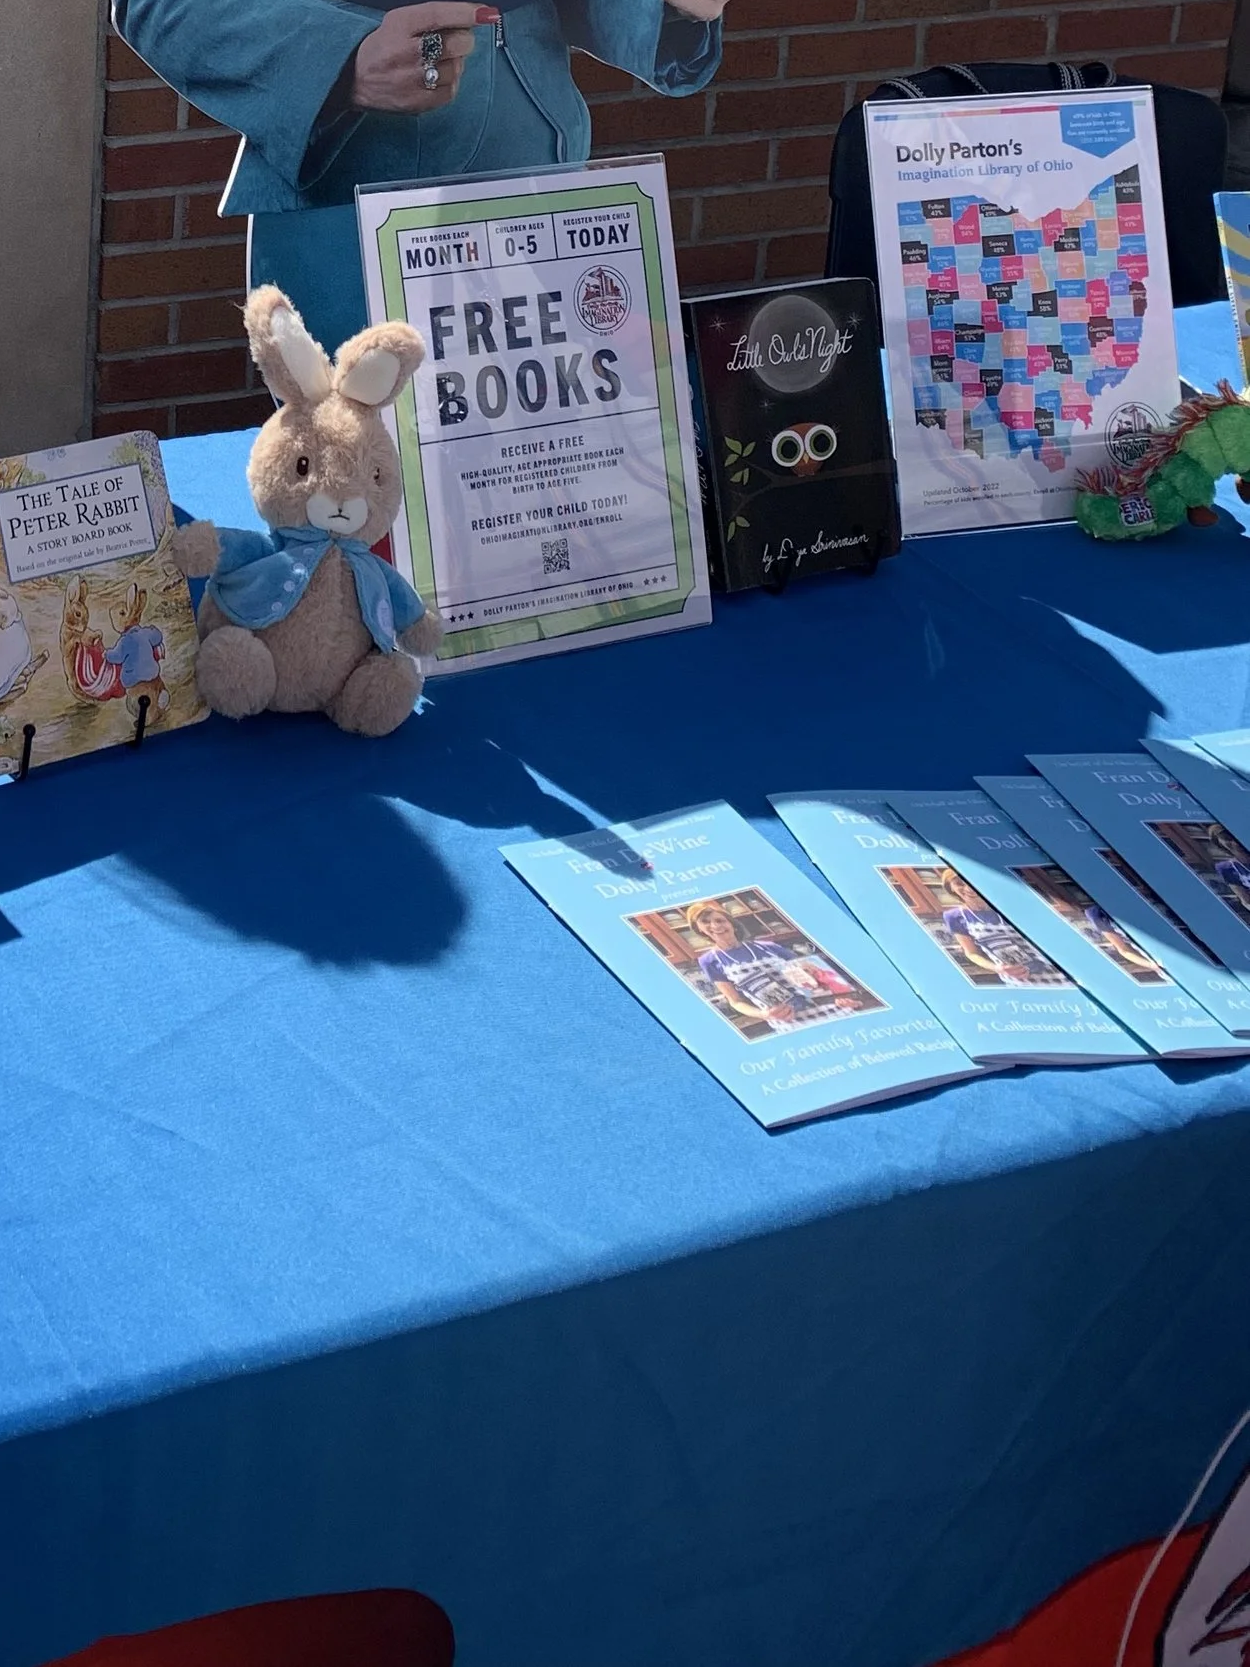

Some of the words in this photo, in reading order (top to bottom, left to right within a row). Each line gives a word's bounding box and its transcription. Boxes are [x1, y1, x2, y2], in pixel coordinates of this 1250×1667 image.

[896, 144, 945, 166] Dolly
[950, 139, 1023, 160] Parton's
[897, 167, 974, 183] Imagination
[978, 164, 1023, 178] Library
[1026, 161, 1039, 173] of
[1042, 160, 1073, 171] Ohio
[495, 224, 526, 234] CHILDREN
[528, 222, 545, 231] AGES
[563, 216, 593, 226] REGISTER
[594, 214, 611, 224] YOUR
[612, 212, 631, 222] CHILD
[412, 234, 428, 244] FREE
[430, 233, 451, 242] BOOKS
[453, 231, 470, 240] EACH
[505, 235, 538, 258] 0-5
[566, 223, 630, 250] TODAY
[406, 241, 479, 270] MONTH
[429, 291, 567, 361] FREE
[726, 334, 764, 371] Little
[806, 326, 854, 373] Night
[436, 348, 622, 426] BOOKS
[501, 441, 545, 458] RECEIVE
[549, 440, 555, 451] A
[559, 435, 585, 449] FREE
[460, 464, 515, 481] HIGH-QUALITY,
[517, 462, 531, 472] AGE
[533, 454, 582, 469] APPROPRIATE
[584, 450, 604, 460] BOOK
[605, 447, 624, 457] EACH
[470, 479, 496, 490] MONTH
[498, 477, 513, 485] FOR
[514, 468, 559, 483] REGISTERED
[560, 462, 596, 476] CHILDREN
[598, 459, 618, 469] FROM
[17, 492, 53, 512] THE
[56, 482, 101, 503] TALE
[104, 476, 124, 492] OF
[512, 484, 535, 495] BIRTH
[536, 482, 545, 490] TO
[547, 479, 561, 489] AGE
[563, 476, 582, 486] FIVE.
[922, 487, 952, 498] Updated
[952, 485, 980, 495] October
[982, 483, 1000, 492] 2022
[7, 512, 70, 540] PETER
[74, 495, 140, 526] RABBIT
[471, 512, 522, 531] REGISTER
[525, 507, 554, 522] YOUR
[557, 501, 588, 516] CHILD
[591, 494, 628, 510] TODAY!
[27, 545, 34, 555] A
[37, 537, 68, 553] STORY
[72, 529, 105, 545] BOARD
[107, 522, 133, 536] BOOK
[762, 543, 774, 573] by
[483, 606, 503, 617] DOLLY
[505, 600, 536, 612] PARTON'S
[537, 593, 579, 607] IMAGINATION
[580, 587, 607, 599] LIBRARY
[608, 585, 617, 593] OF
[617, 582, 634, 591] OHIO
[1093, 771, 1144, 784] Fran
[1118, 792, 1182, 809] Dolly
[830, 810, 883, 825] Fran
[949, 812, 1001, 826] Fran
[565, 855, 621, 874] Fran
[618, 834, 711, 864] DeWine
[854, 834, 920, 853] Dolly
[594, 878, 658, 900] Dolly
[659, 857, 734, 884] Parton
[959, 999, 999, 1015] Our
[1006, 999, 1082, 1018] Family
[1133, 998, 1171, 1010] Our
[977, 1022, 989, 1033] A
[992, 1020, 1068, 1034] Collection
[1070, 1020, 1085, 1034] of
[1088, 1021, 1123, 1034] Belo
[740, 1057, 777, 1076] Our
[782, 1034, 855, 1066] Family
[762, 1083, 775, 1097] A
[774, 1062, 847, 1091] Collection
[849, 1056, 862, 1070] of
[861, 1044, 916, 1066] Beloved
[915, 1037, 960, 1053] Recip
